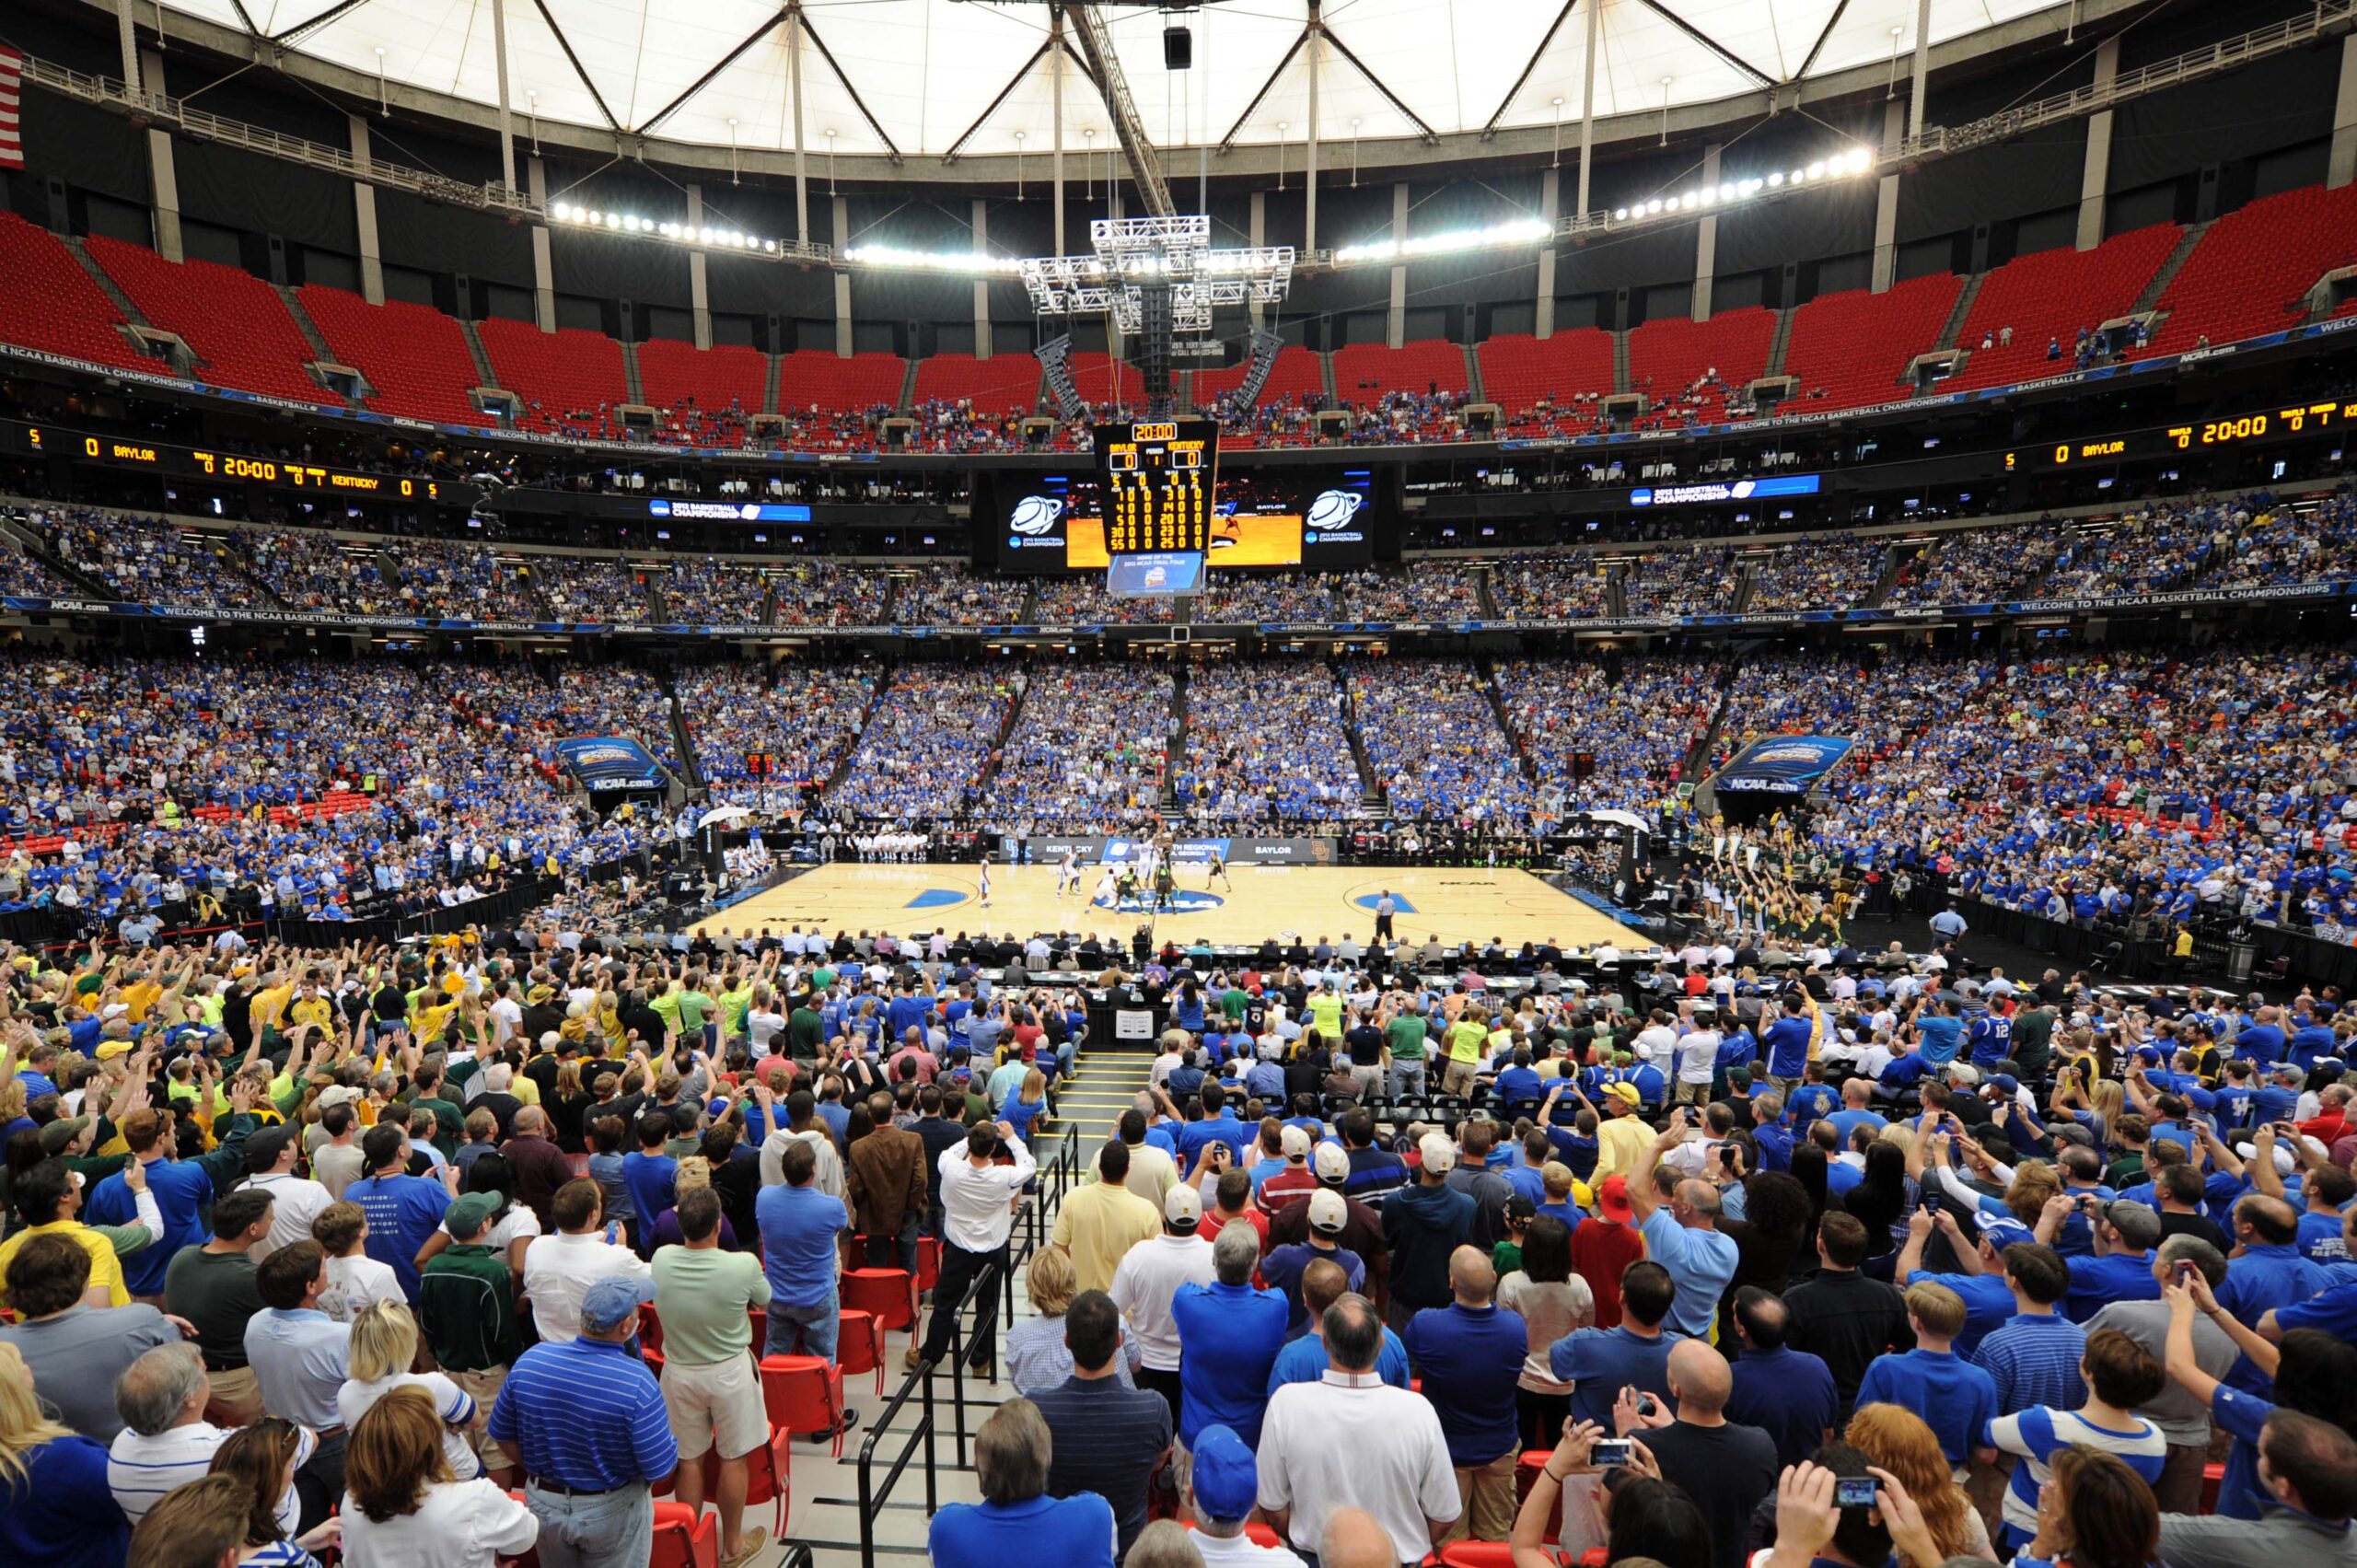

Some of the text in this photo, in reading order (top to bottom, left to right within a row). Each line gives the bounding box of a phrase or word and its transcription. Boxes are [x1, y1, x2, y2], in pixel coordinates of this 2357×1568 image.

[2180, 345, 2235, 363] NCAA.com
[10, 347, 42, 361] NCAA
[44, 354, 110, 375] BASKETBALL
[112, 369, 195, 390] CHAMPIONSHIPS
[2016, 376, 2075, 392] BASKETBALL
[256, 396, 309, 411] BASKETBALL
[1730, 421, 1770, 431] WELCOME
[1802, 413, 1826, 423] NCAA
[1827, 406, 1880, 420] BASKETBALL
[1882, 395, 1955, 412] CHAMPIONSHIPS
[2322, 412, 2328, 425] 1
[393, 417, 435, 430] NCAA.com
[2202, 416, 2267, 443] 20:00
[2291, 416, 2303, 430] 0
[29, 429, 41, 443] 5
[1136, 424, 1173, 440] 20:00
[86, 438, 99, 457] 0
[490, 430, 528, 440] WELCOME
[540, 436, 556, 444] THE
[556, 437, 578, 447] NCAA
[578, 439, 625, 450] BASKETBALL
[625, 443, 682, 454] CHAMPIONSHIPS
[1167, 440, 1204, 451] KENTUCKY
[1529, 439, 1569, 447] BASKETBALL
[2178, 435, 2189, 447] 0
[113, 445, 156, 461] BAYLOR
[1109, 443, 1137, 453] BAYLOR
[2055, 446, 2069, 463] 0
[2083, 441, 2124, 457] BAYLOR
[1125, 454, 1134, 469] 0
[1155, 456, 1158, 466] 1
[1188, 451, 1196, 466] 0
[2005, 453, 2014, 466] 5
[204, 460, 214, 473] 0
[225, 458, 275, 481] 20:00
[295, 473, 304, 486] 0
[317, 475, 322, 486] 1
[331, 475, 379, 489] KENTUCKY
[1112, 476, 1120, 488] 5
[1139, 475, 1146, 486] 0
[1171, 475, 1178, 486] 0
[1191, 473, 1199, 484] 5
[401, 480, 412, 495] 0
[429, 482, 437, 495] 5
[1655, 484, 1727, 496] 2012 BASKETBALL
[1120, 490, 1151, 502] 1 0 0
[1167, 488, 1202, 501] 3 0 0
[1654, 491, 1731, 504] CHAMPIONSHIP
[691, 503, 735, 511] BASKETBALL
[1116, 502, 1151, 514] 4 0 0
[1164, 501, 1202, 512] 14 0 0
[672, 509, 740, 519] CHAMPIONSHIP
[1117, 514, 1152, 526] 5 0 0
[1160, 513, 1202, 524] 20 0 0
[1111, 526, 1152, 538] 30 0 0
[1160, 525, 1202, 536] 23 0 0
[1111, 538, 1152, 550] 55 0 0
[1160, 536, 1202, 549] 25 0 0
[2020, 600, 2073, 611] WELCOME
[2094, 598, 2114, 607] THE
[2118, 596, 2149, 606] NCAA
[2151, 591, 2226, 604] BASKETBALL
[2229, 584, 2330, 598] CHAMPIONSHIPS
[51, 600, 110, 612] NCAA.com
[164, 607, 416, 626] WELCOME TO THE NCAA BASKETBALL CHAMPIONSHIPS
[1894, 609, 1943, 617] NCAA.com
[477, 622, 527, 631] BASKETBALL
[1620, 618, 1683, 626] CHAMPIONIPS
[709, 626, 745, 634] WELCOME
[839, 626, 892, 634] CHAMPIONSHIPS
[594, 778, 654, 790] NCAA.com
[1731, 779, 1798, 792] NCAA.com
[1995, 1024, 2009, 1038] 12
